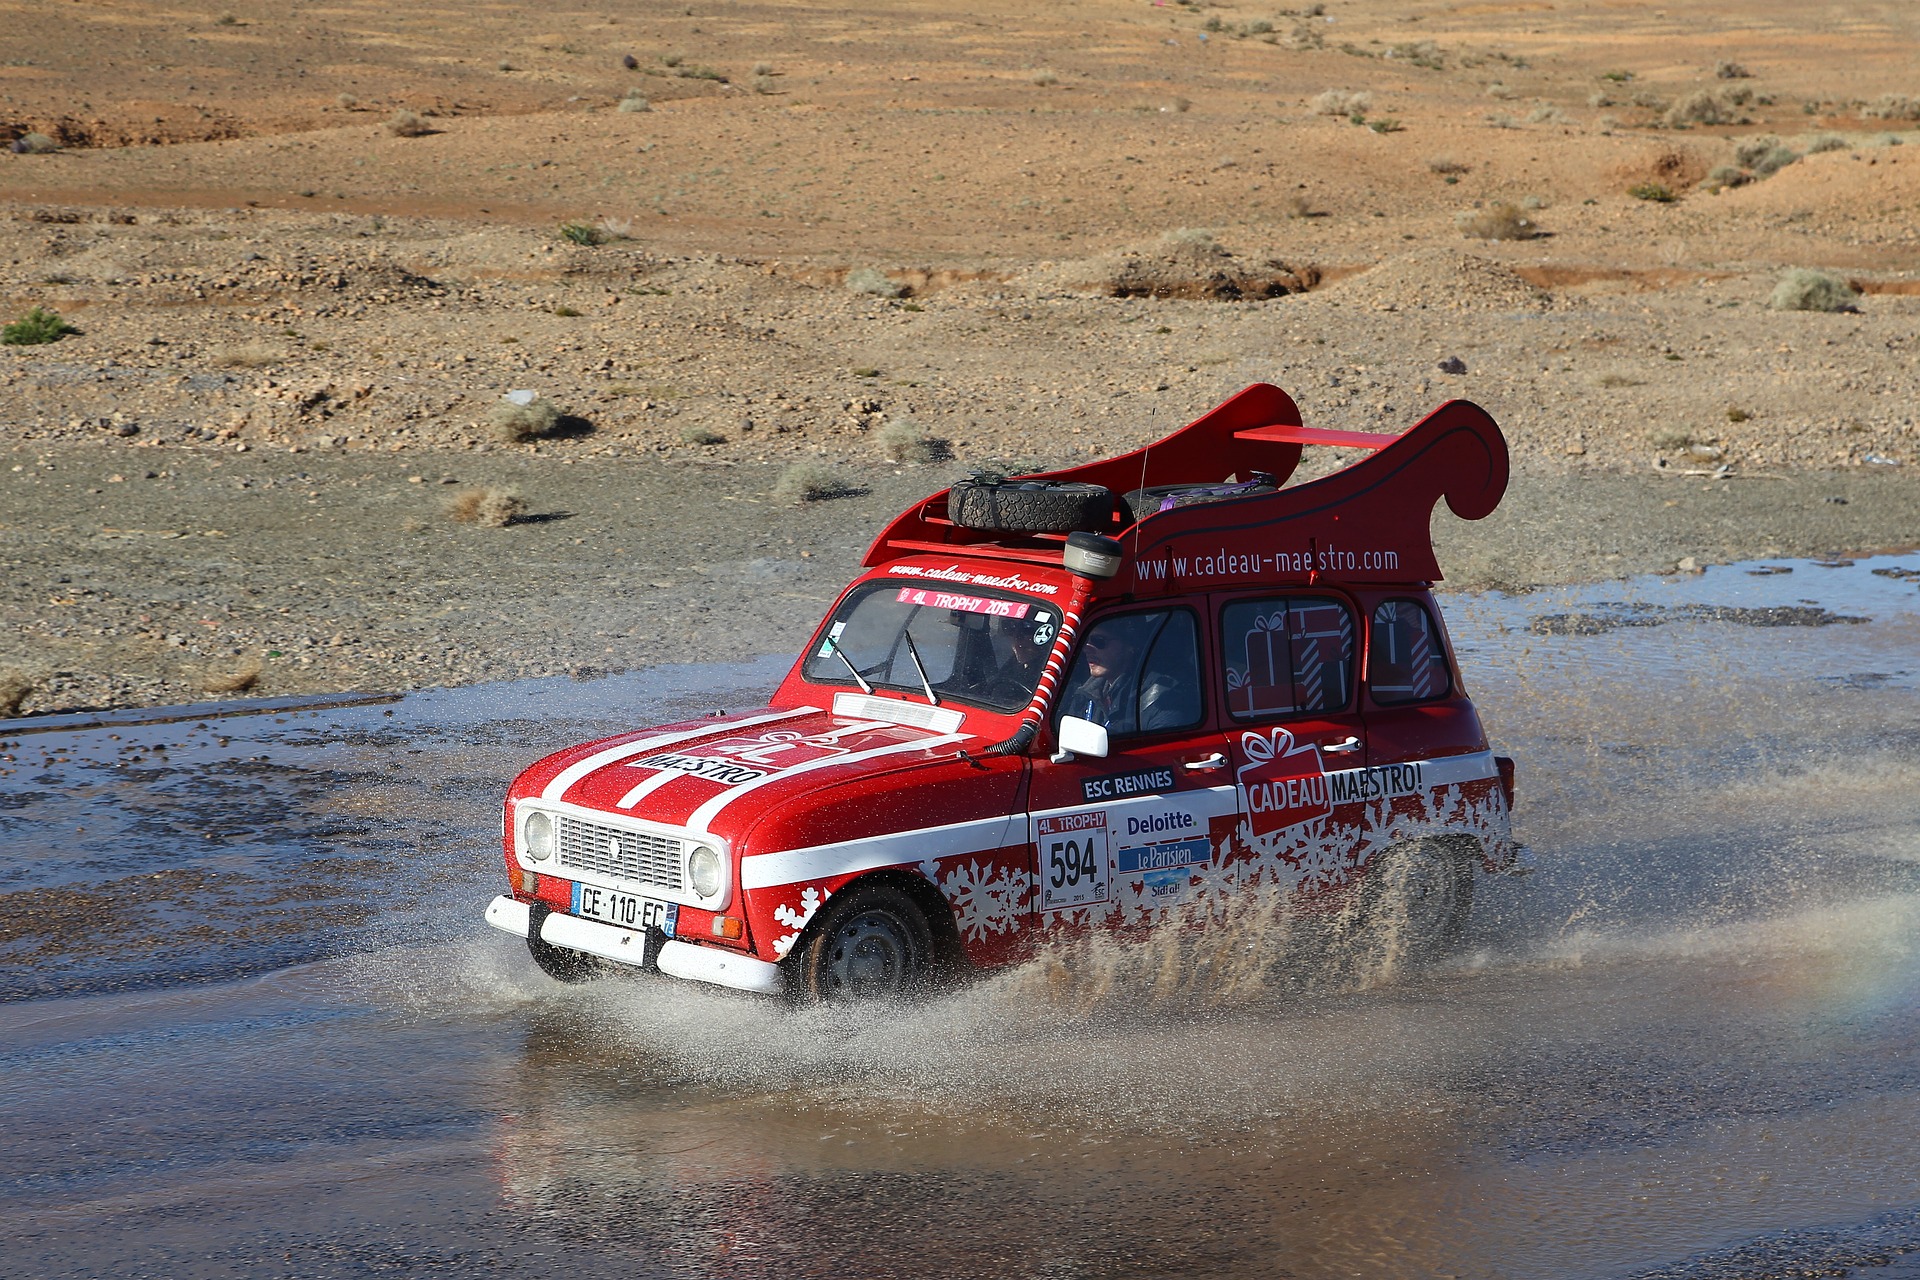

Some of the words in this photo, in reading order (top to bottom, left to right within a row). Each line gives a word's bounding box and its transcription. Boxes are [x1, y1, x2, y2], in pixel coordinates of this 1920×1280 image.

[1136, 544, 1399, 580] www.cadeau-maestro.com
[888, 564, 1059, 595] www.cadeau-maestro.com
[912, 591, 926, 605] 4L
[933, 593, 982, 611] TROPHY
[984, 601, 1013, 616] 2015
[1084, 780, 1112, 798] ESC
[1114, 770, 1173, 794] RENNES
[1331, 762, 1423, 803] MAESTRO!
[1039, 819, 1055, 833] 4L
[1058, 811, 1105, 831] TROPHY
[1050, 837, 1097, 889] 594
[1149, 845, 1192, 869] Parisien
[664, 920, 675, 935] 73
